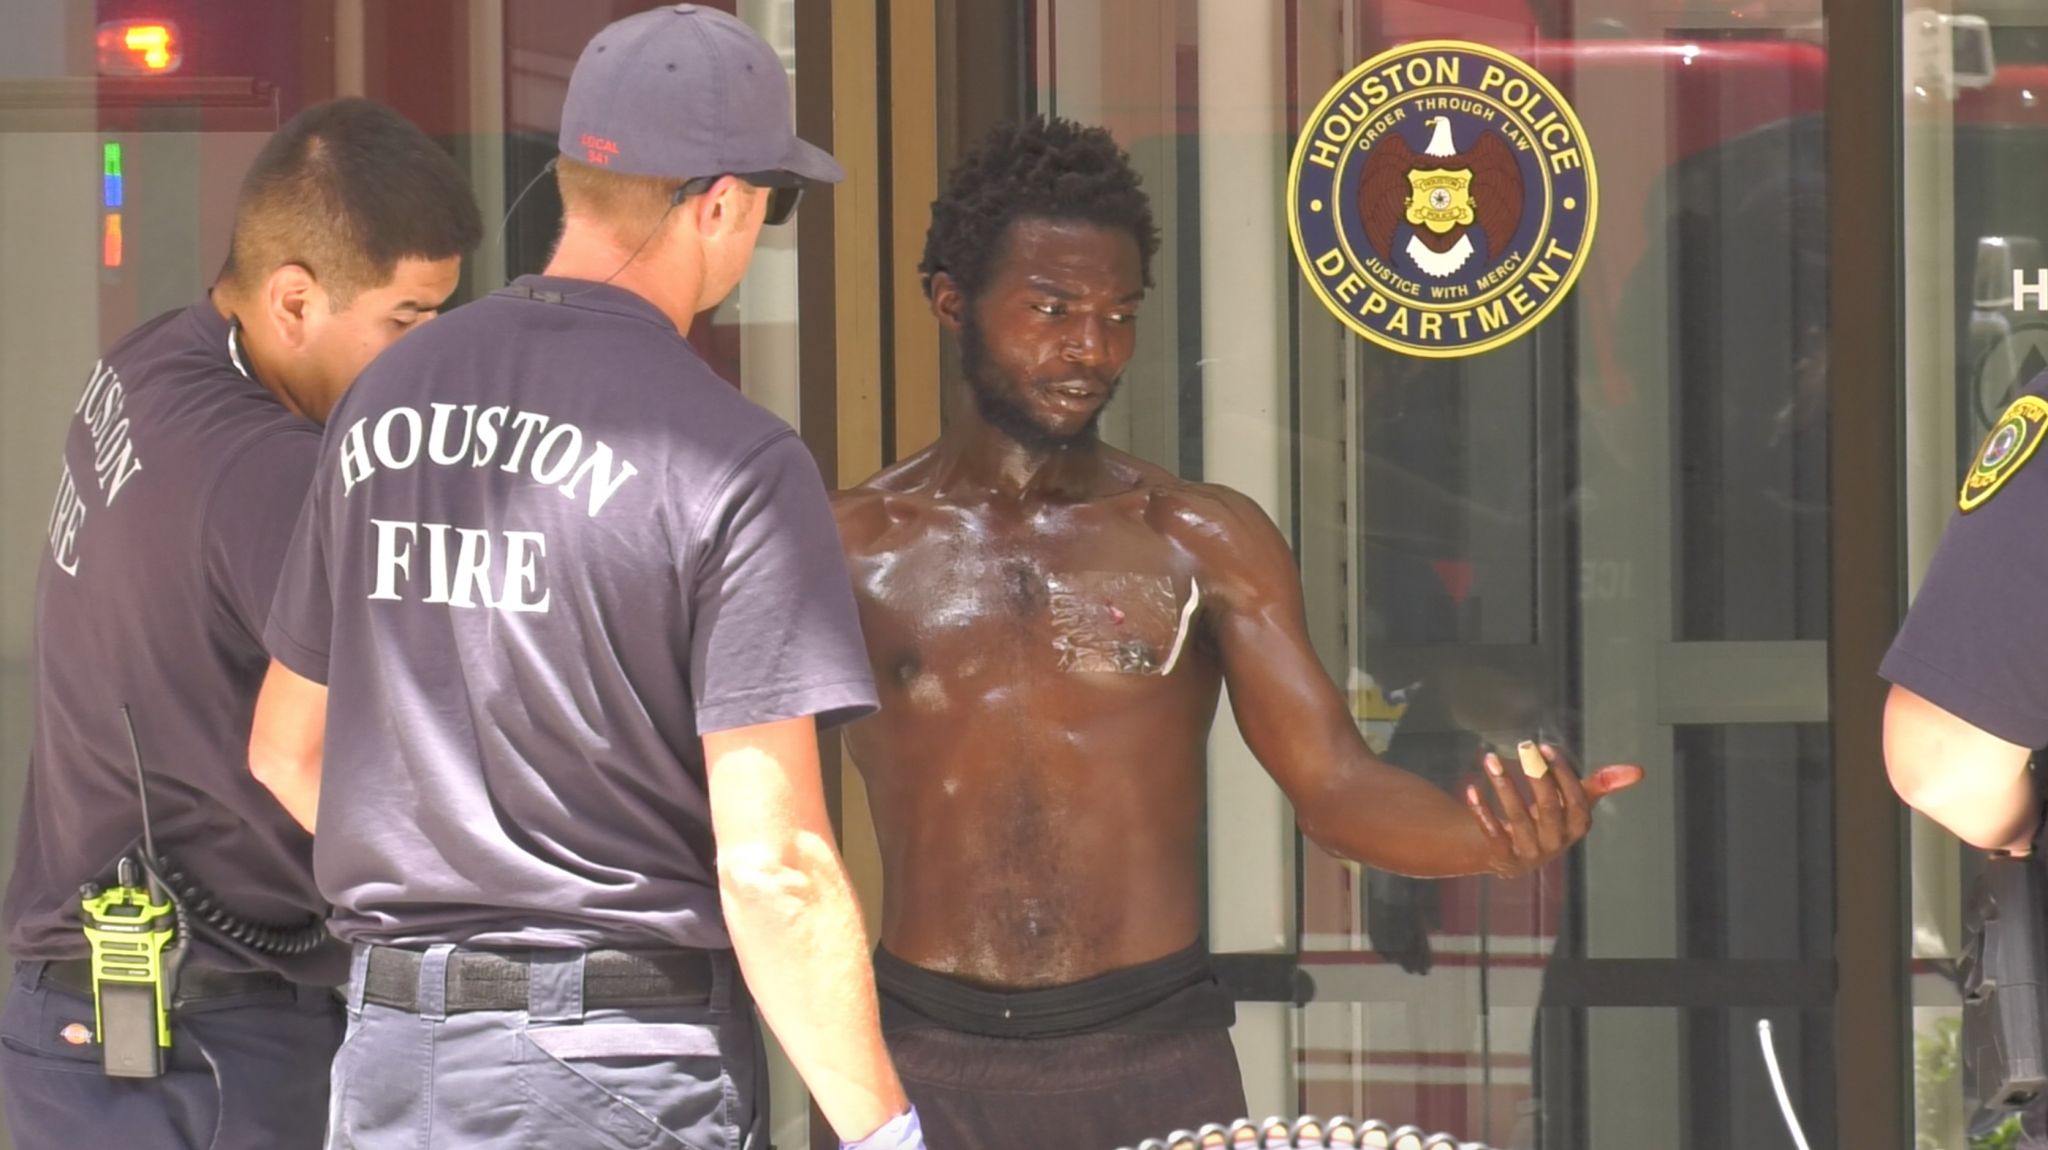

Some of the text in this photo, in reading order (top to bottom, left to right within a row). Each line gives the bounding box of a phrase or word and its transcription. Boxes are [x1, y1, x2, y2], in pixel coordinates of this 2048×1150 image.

[1310, 57, 1581, 175] HOUSTON POLICE
[1359, 97, 1531, 151] ORDER THROUGH LAW
[1315, 238, 1573, 341] DEPARTMENT
[1365, 251, 1522, 299] JUSTICE WITH MERCY
[2013, 268, 2048, 311] H
[340, 402, 639, 518] HOUSTON
[367, 518, 550, 613] FIRE
